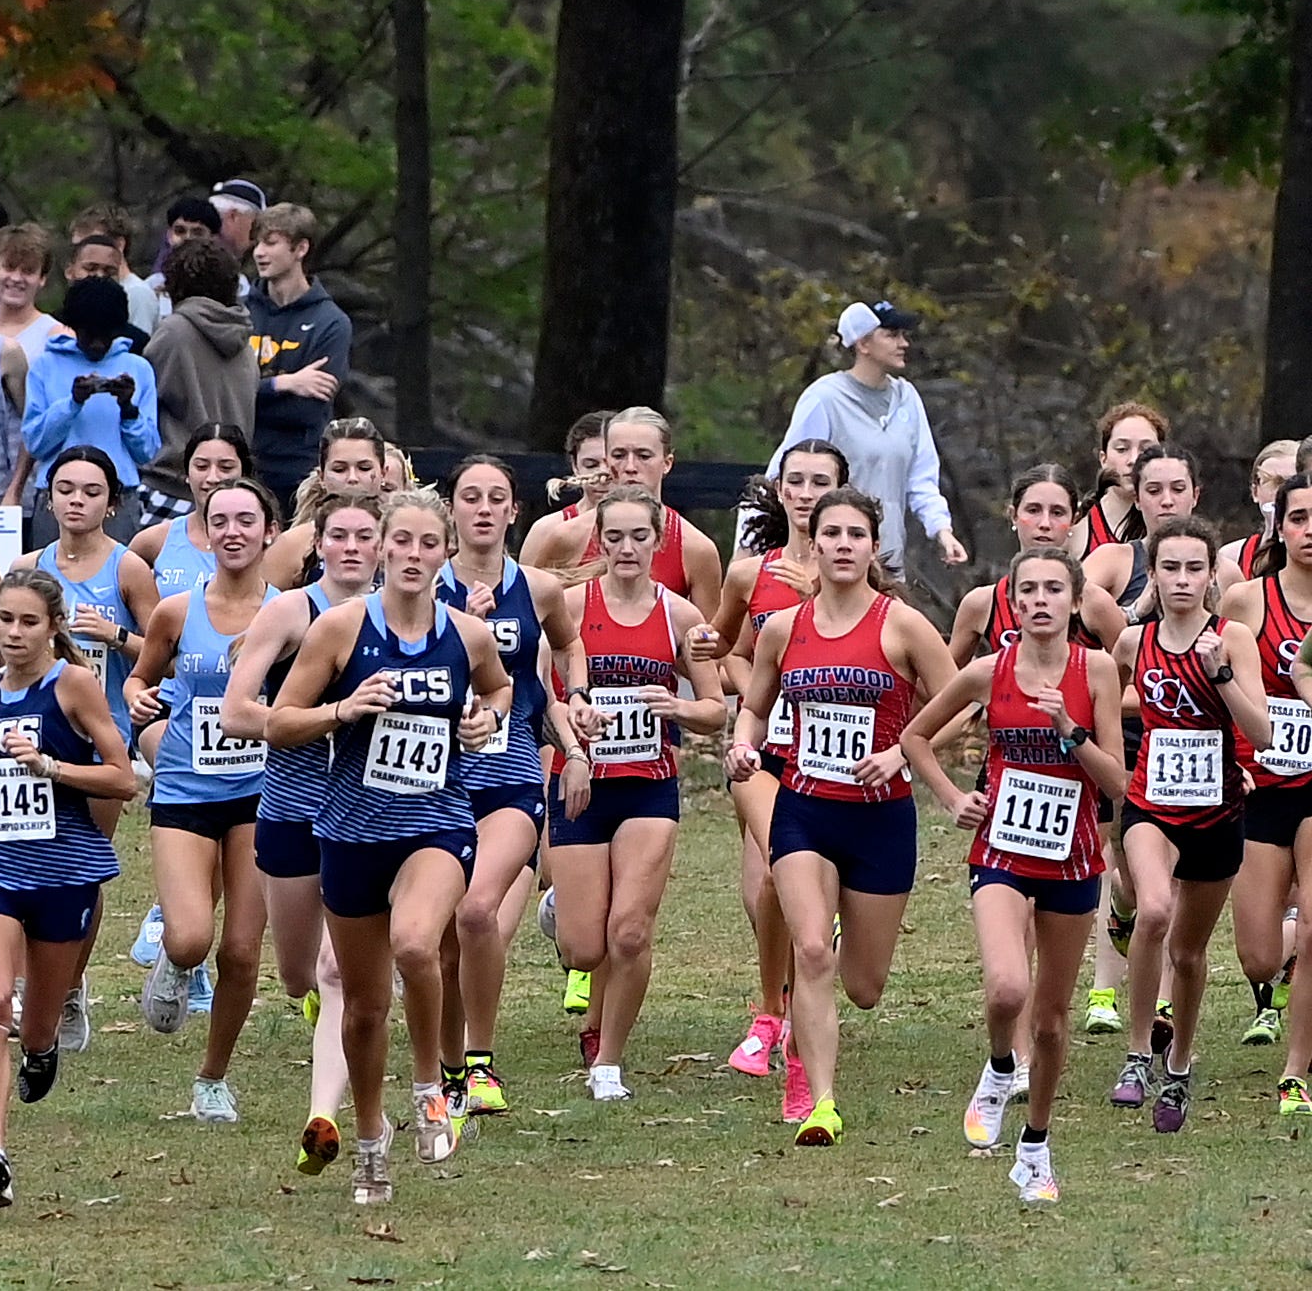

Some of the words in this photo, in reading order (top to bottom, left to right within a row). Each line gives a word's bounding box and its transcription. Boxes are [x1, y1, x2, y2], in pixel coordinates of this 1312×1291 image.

[183, 653, 208, 673] ST.
[595, 696, 623, 706] TSSAA
[1143, 668, 1204, 718] SCA
[199, 705, 220, 715] TSSA
[806, 708, 832, 721] TSSAA
[833, 713, 857, 725] STATE
[382, 719, 411, 732] TSSAA
[600, 709, 657, 742] 119
[595, 743, 658, 756] CHAMPIONSHIPS
[807, 724, 868, 762] 1116
[1156, 737, 1180, 747] TSSAA
[1181, 737, 1206, 747] STATE
[198, 754, 264, 766] CHAMPIONSHIPS
[375, 735, 444, 775] 1143
[1155, 752, 1217, 784] 1311
[370, 769, 440, 790] CHAMPIONSHIPS
[1008, 777, 1036, 792] TSSAA
[1037, 783, 1063, 797] STATE
[1152, 787, 1218, 798] CHAMPIONSHIPS
[1002, 794, 1071, 836] 1115
[996, 830, 1066, 852] CHAMPIONSHIPS
